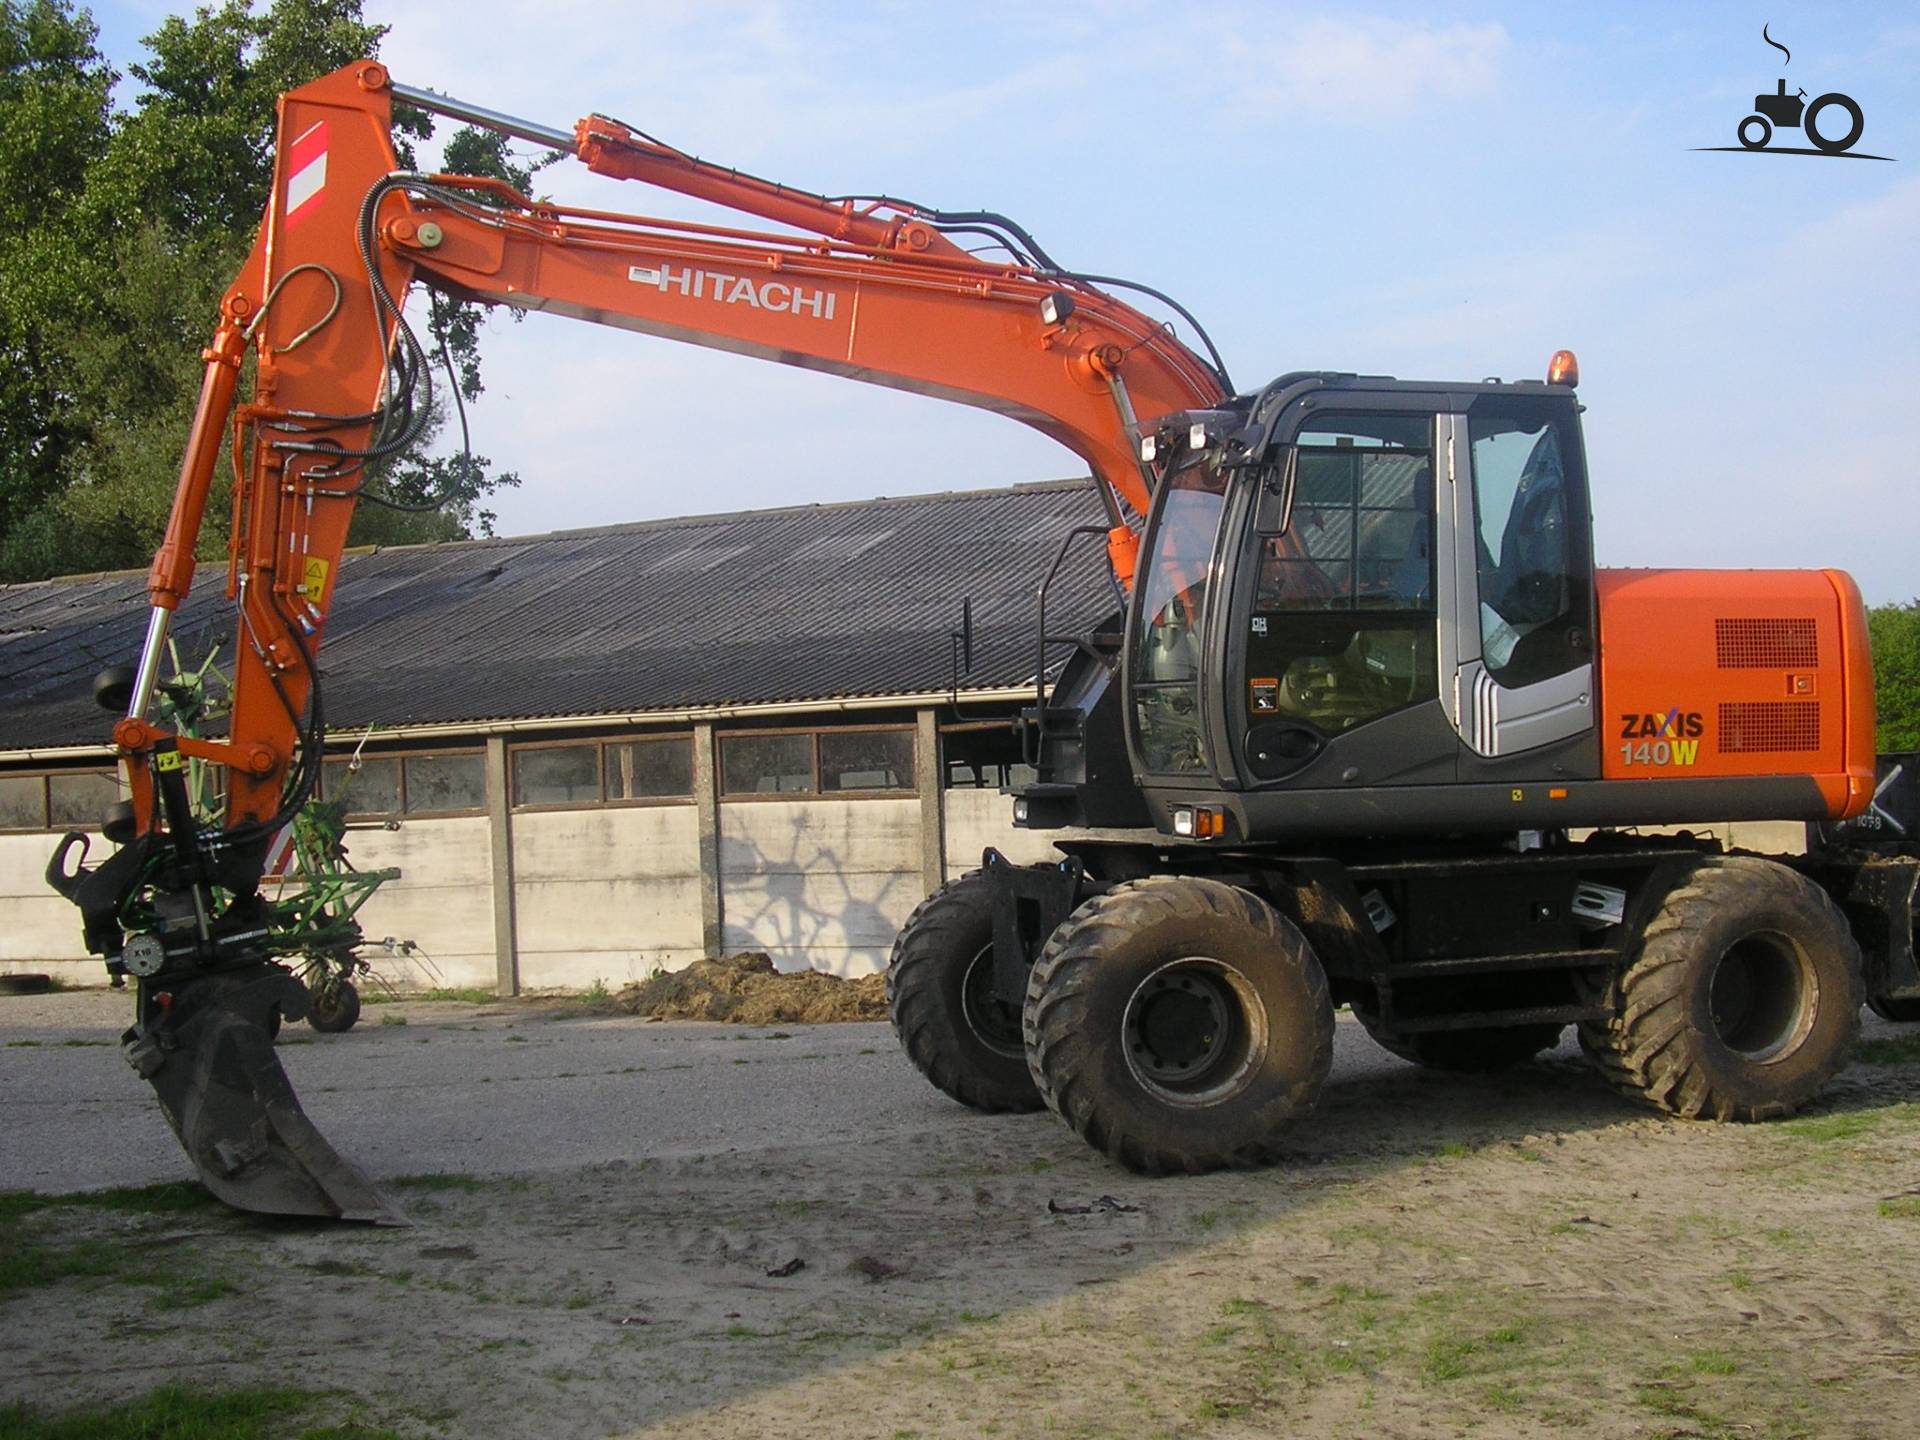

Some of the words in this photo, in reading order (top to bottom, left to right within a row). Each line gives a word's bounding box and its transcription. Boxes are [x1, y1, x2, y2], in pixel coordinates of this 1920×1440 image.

[659, 263, 837, 321] HITACHI
[1621, 708, 1704, 739] ZAXIS
[1621, 740, 1699, 766] 140W
